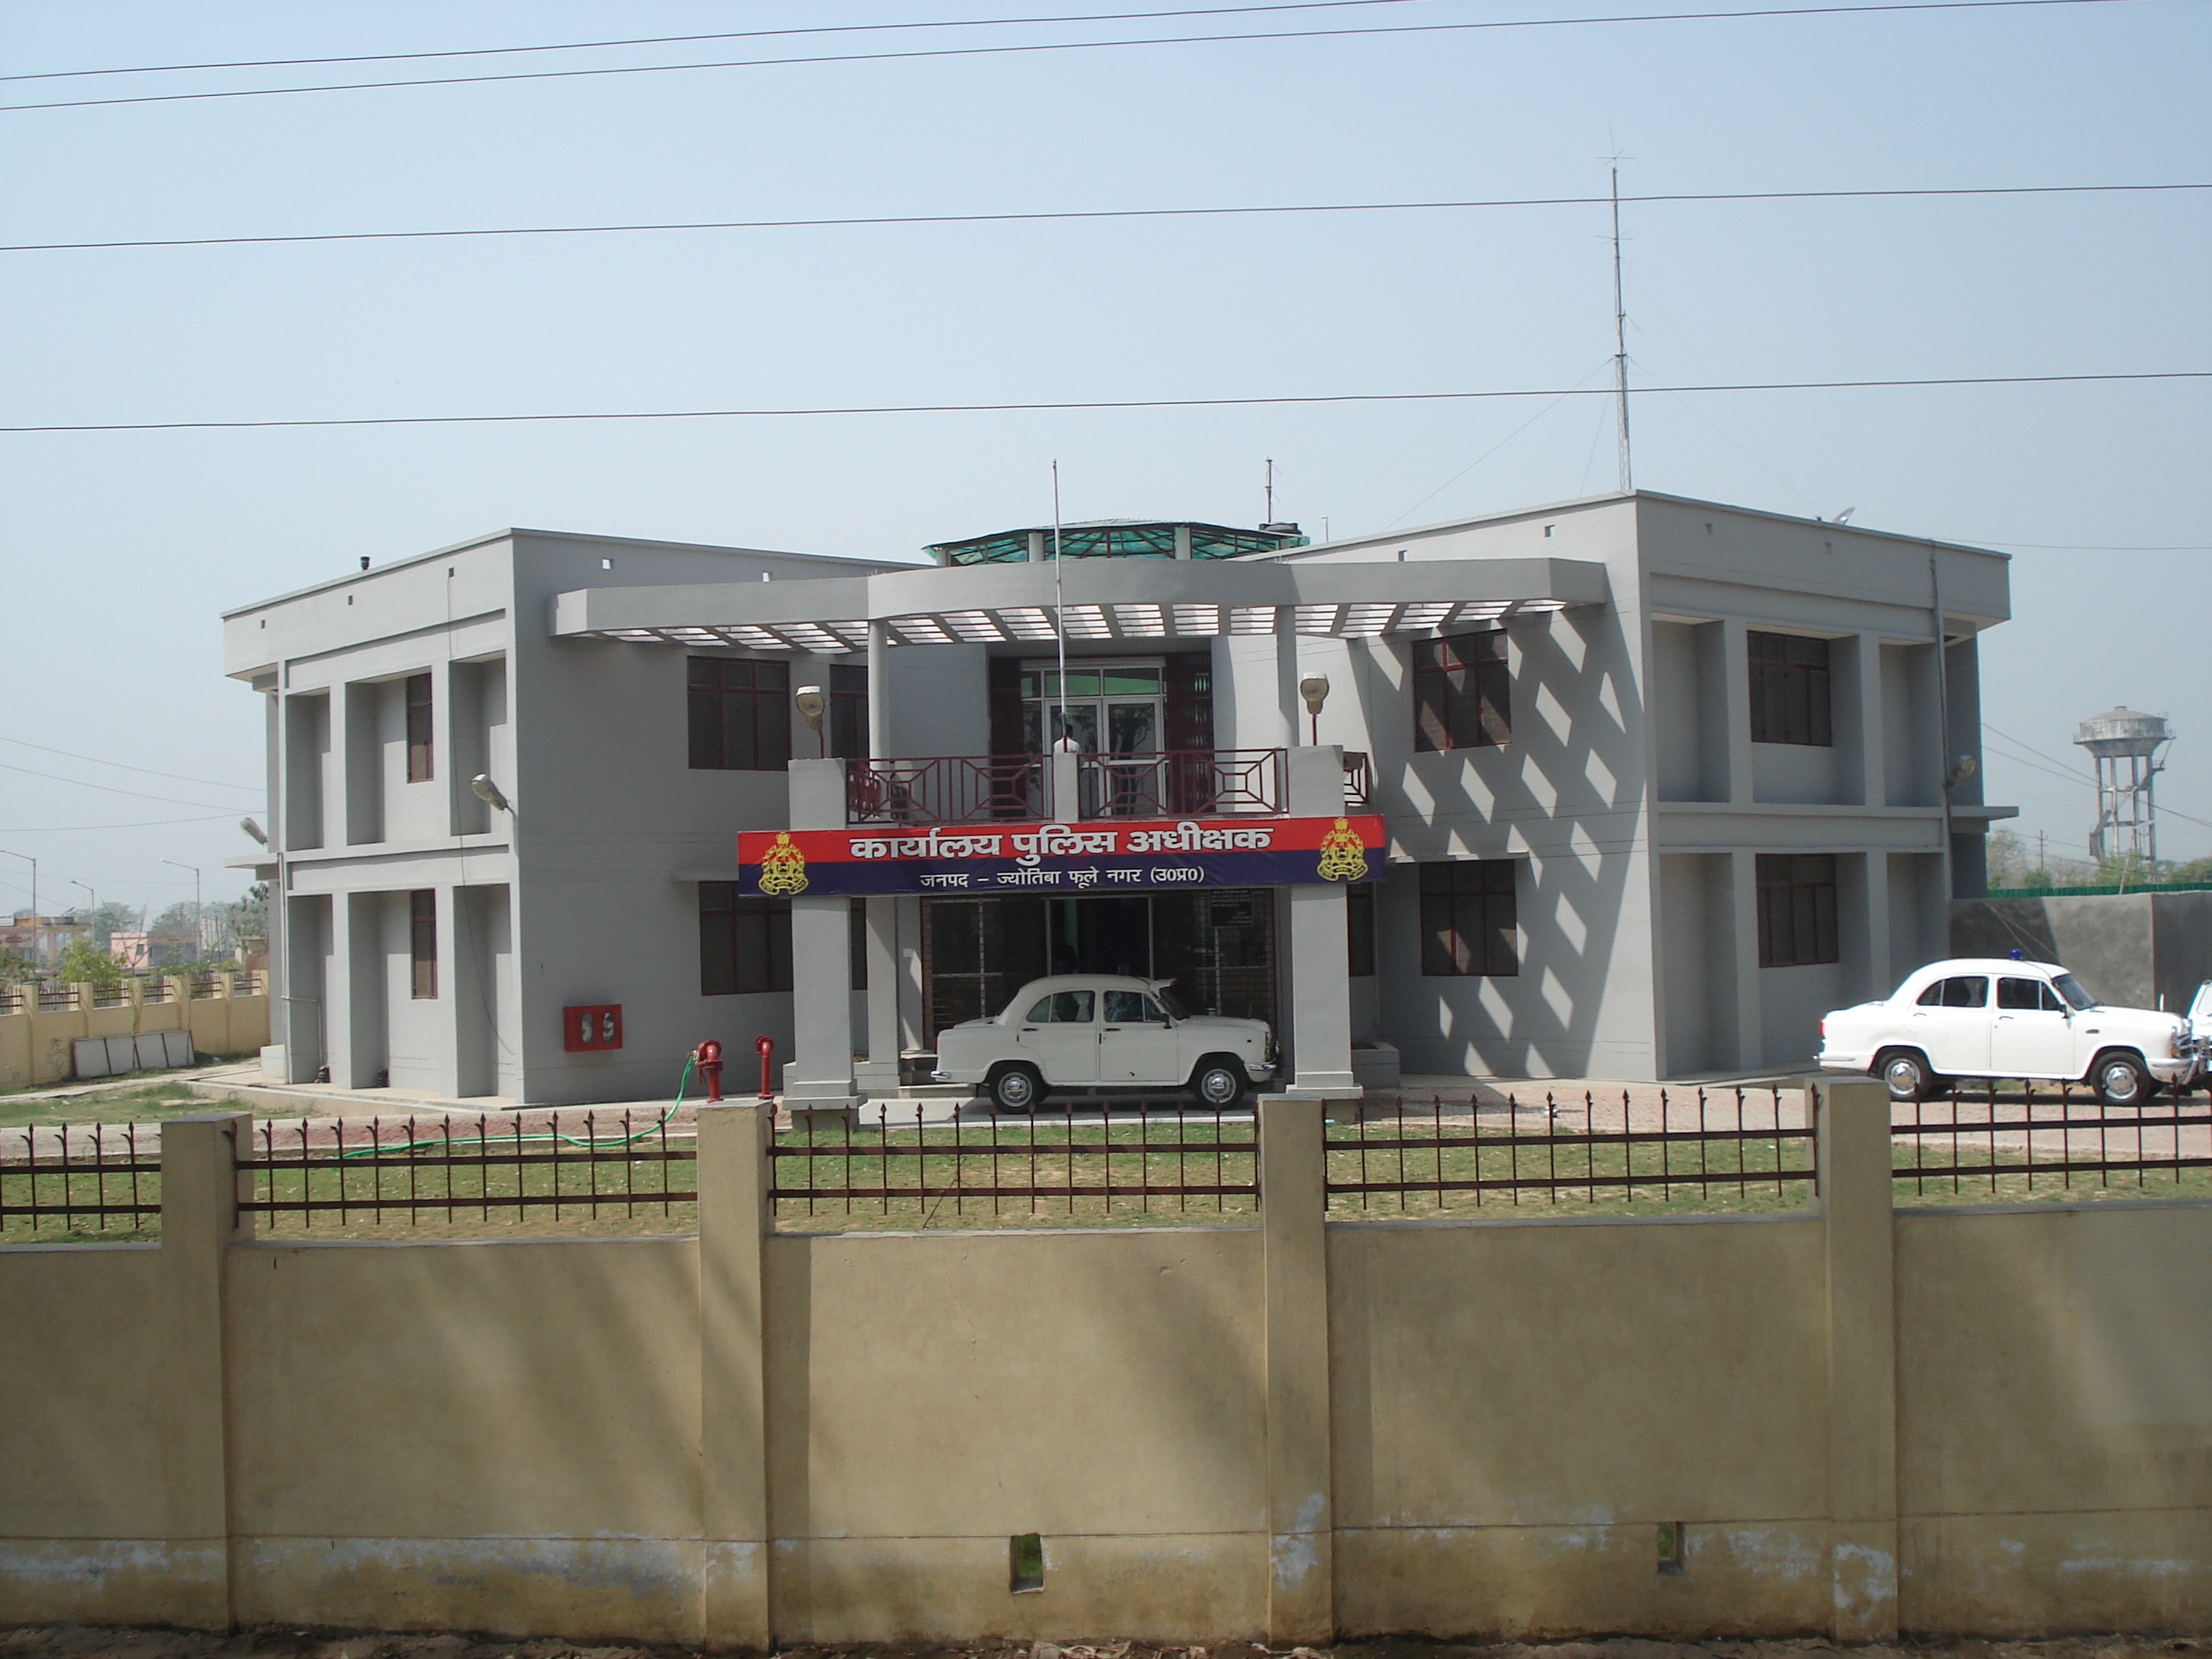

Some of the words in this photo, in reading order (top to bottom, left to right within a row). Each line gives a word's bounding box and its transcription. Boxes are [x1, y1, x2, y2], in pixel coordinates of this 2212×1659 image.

[848, 827, 1004, 859] कार्यालय
[1010, 824, 1119, 867] पुलिस
[1126, 821, 1274, 853] अधीक्षक
[920, 873, 969, 888] जनपद
[996, 868, 1062, 886] ज्योतिबा
[1068, 866, 1100, 889] फूले
[1105, 868, 1143, 884] नगर
